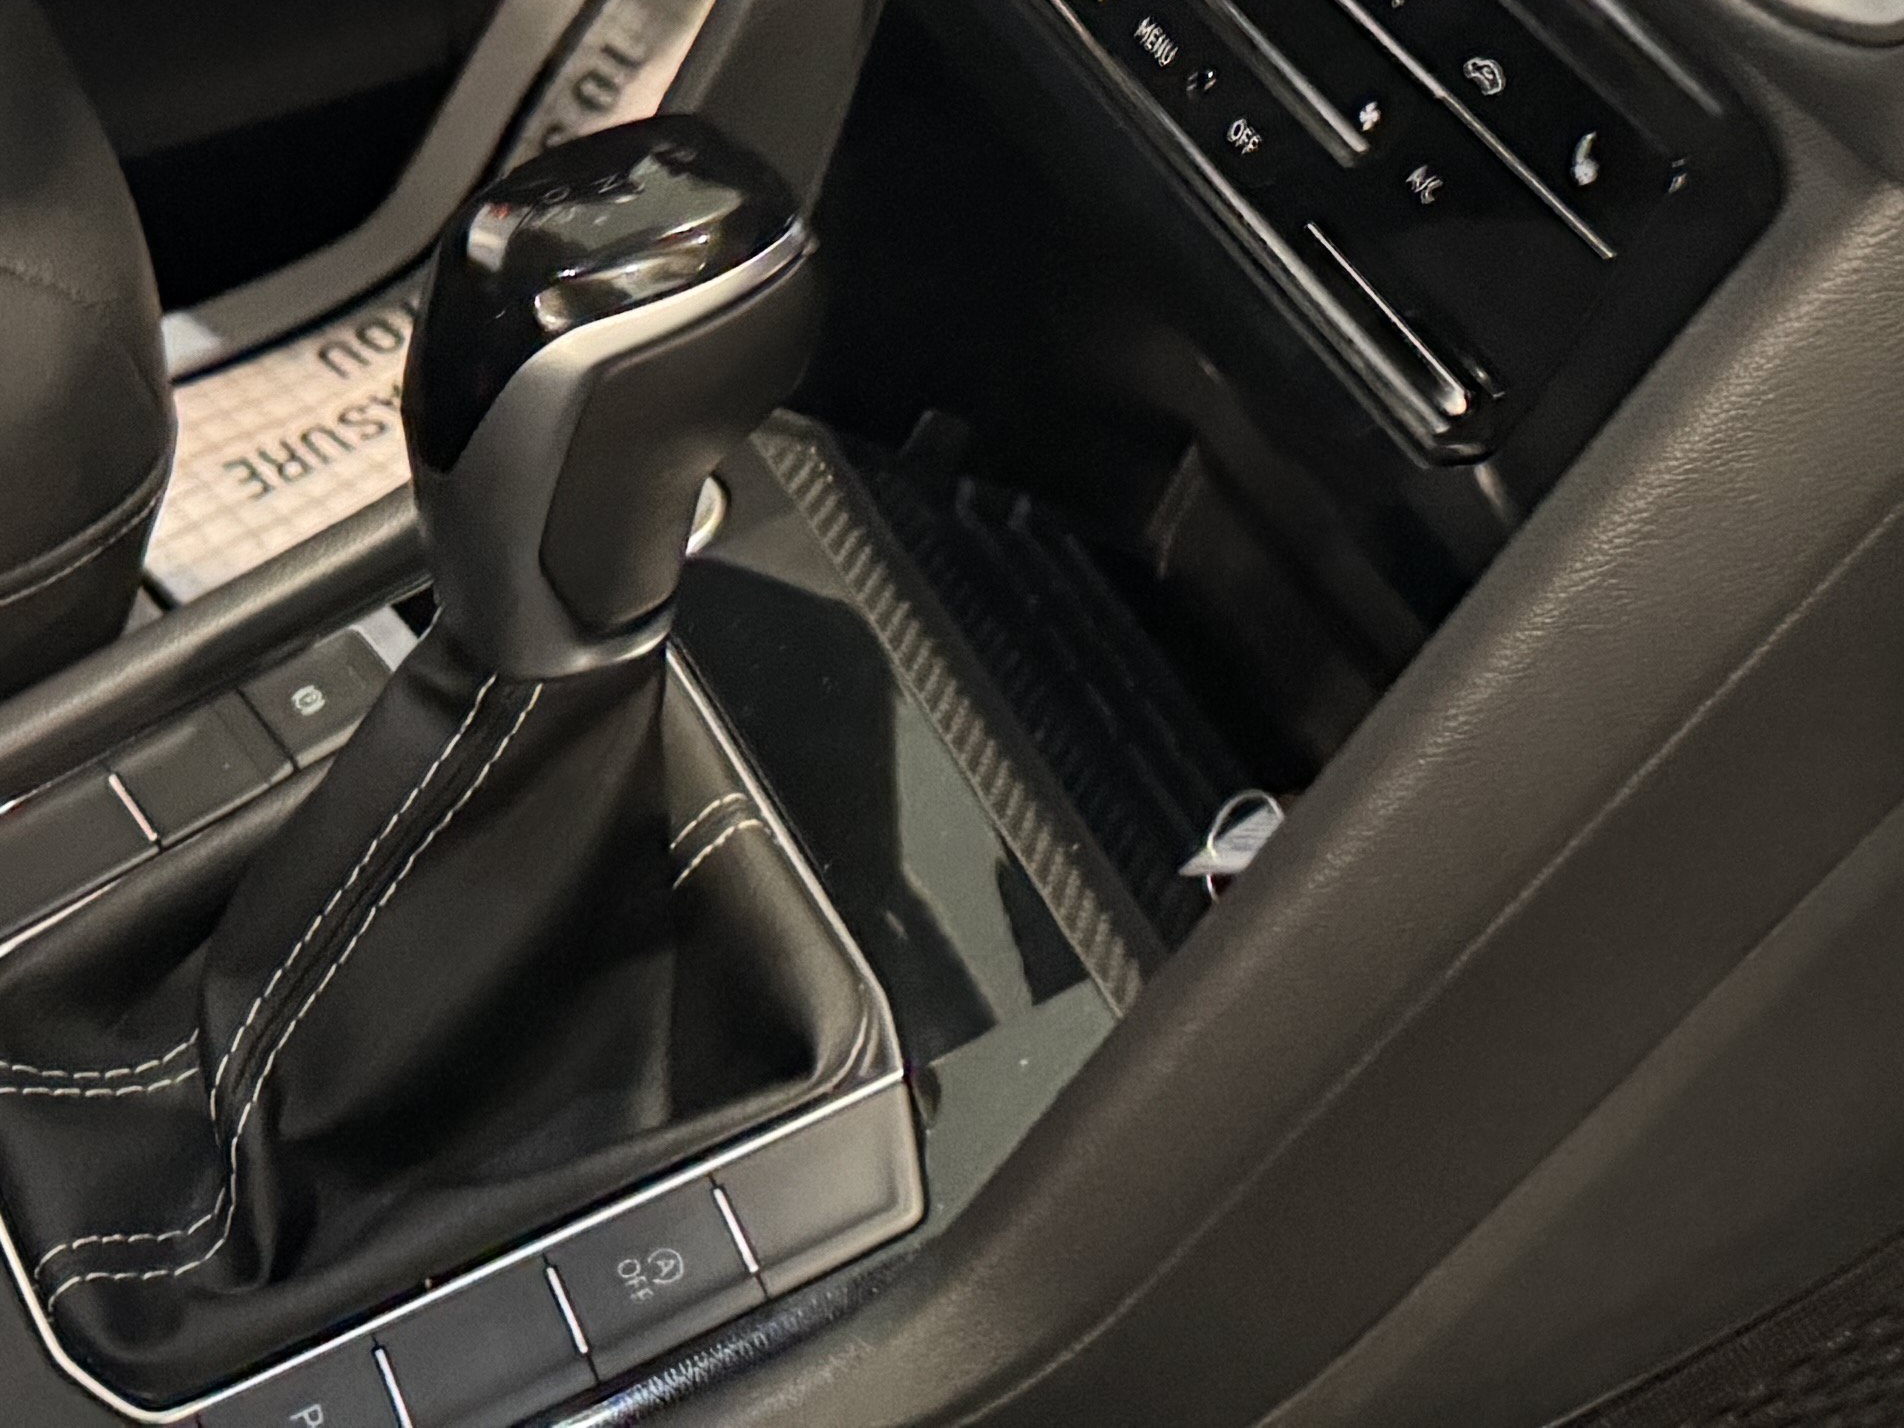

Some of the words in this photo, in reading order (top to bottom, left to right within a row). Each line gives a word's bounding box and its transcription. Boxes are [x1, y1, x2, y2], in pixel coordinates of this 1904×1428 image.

[1134, 15, 1178, 67] MENU
[1227, 117, 1262, 155] OFF
[617, 1258, 655, 1301] OFF
